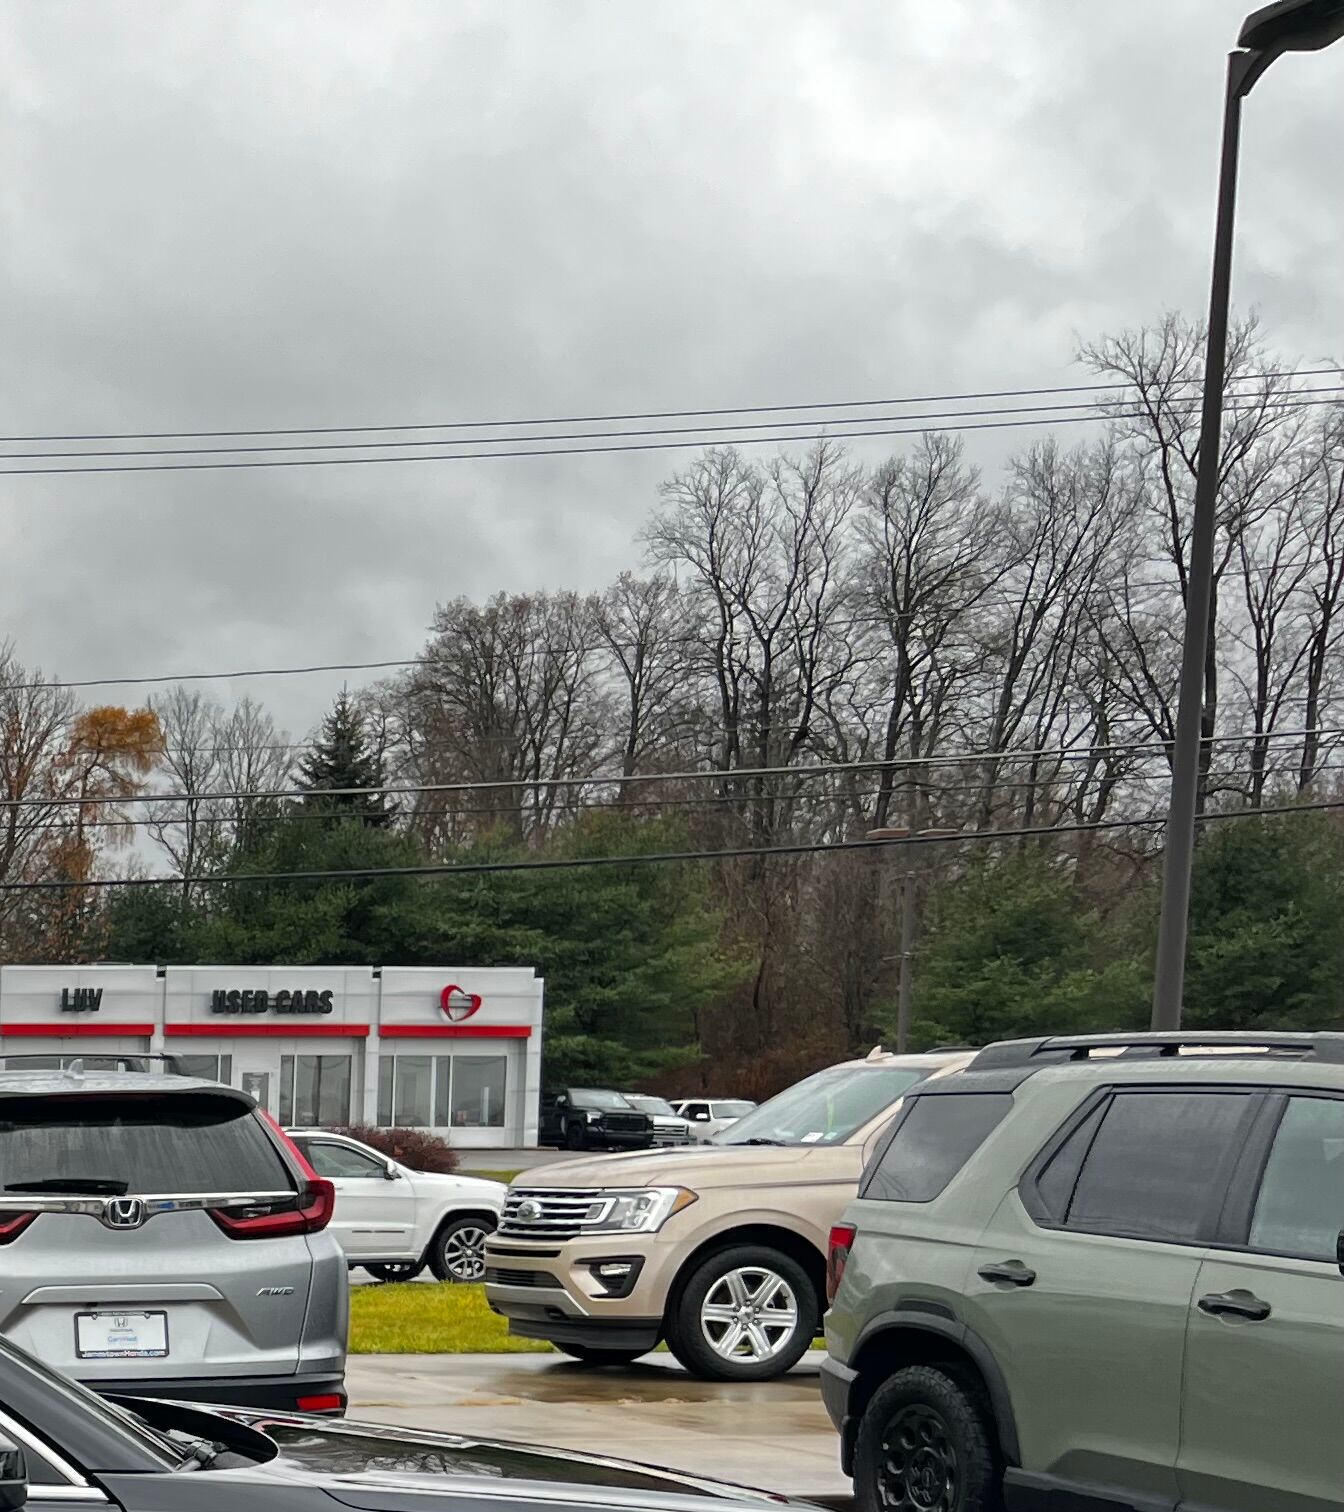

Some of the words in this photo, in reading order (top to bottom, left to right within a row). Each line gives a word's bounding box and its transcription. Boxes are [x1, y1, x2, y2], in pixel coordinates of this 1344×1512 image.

[60, 987, 104, 1012] LUV
[210, 989, 269, 1014] USED
[275, 989, 334, 1014] CARS
[255, 1285, 294, 1297] AWD
